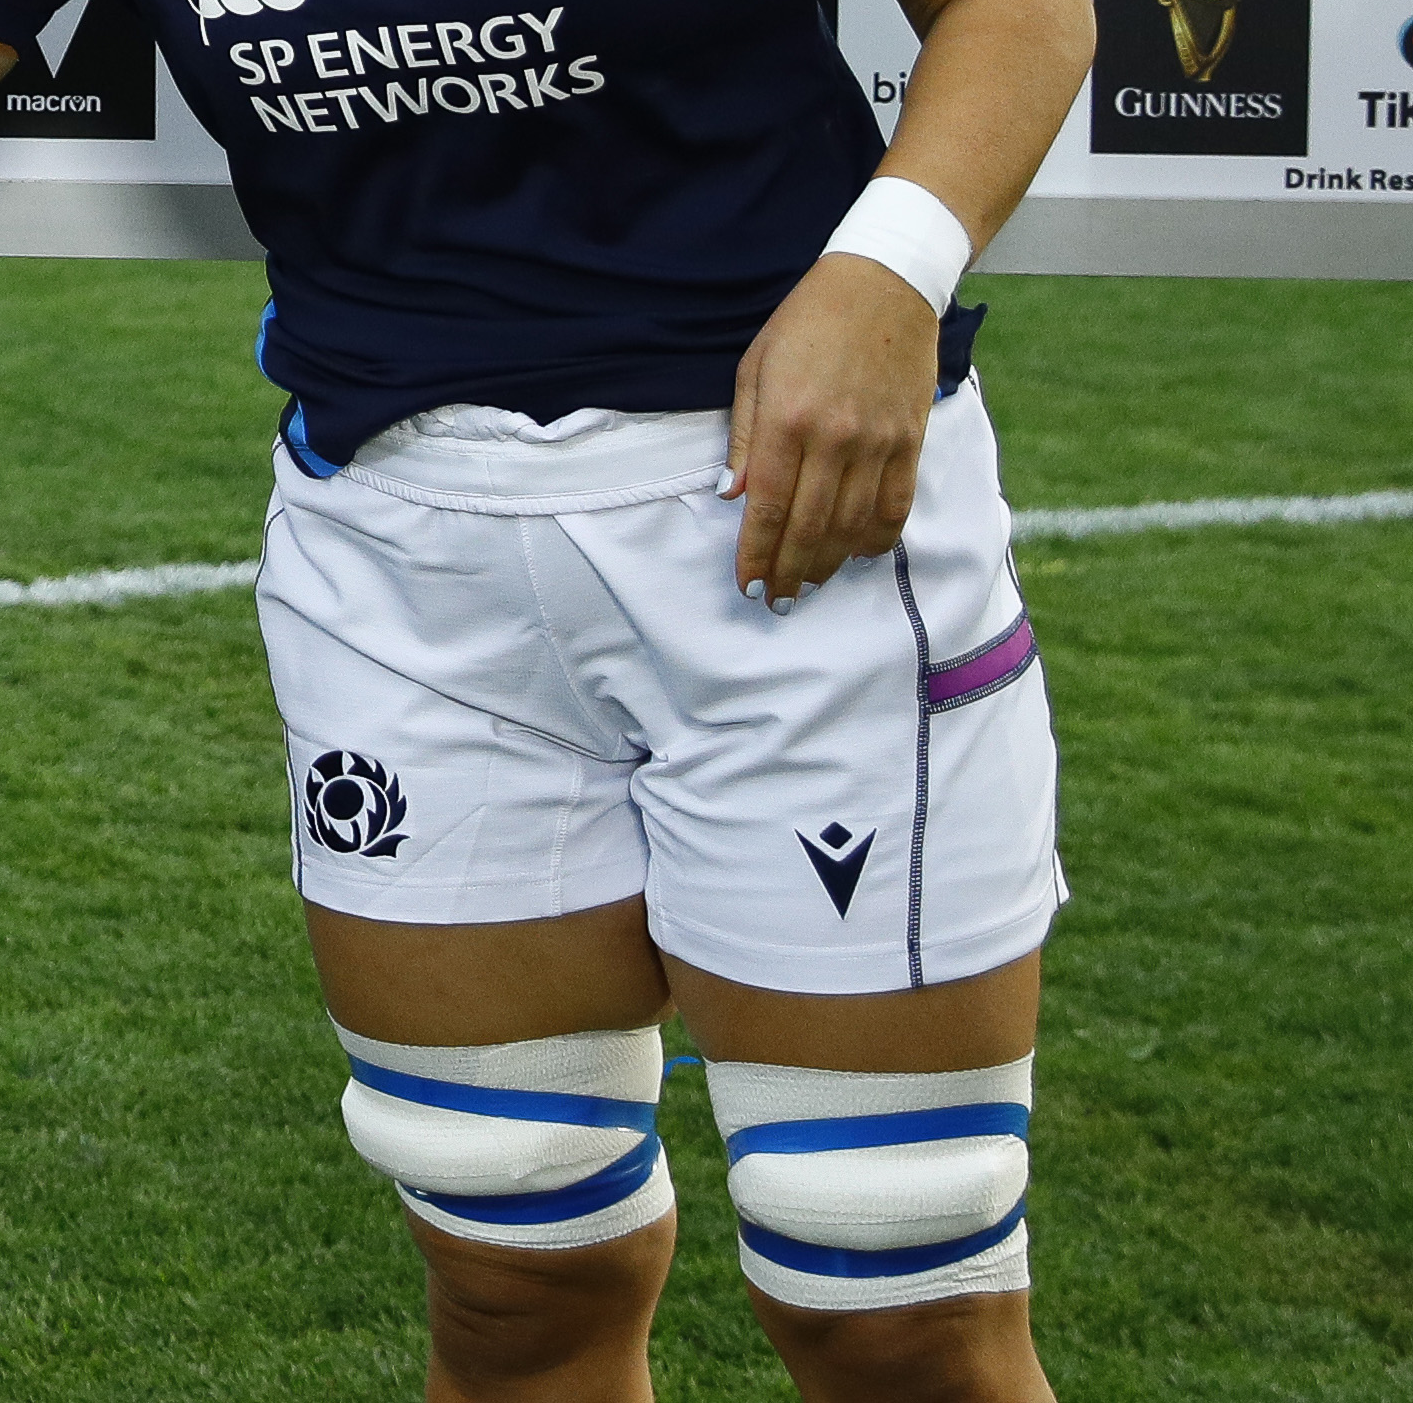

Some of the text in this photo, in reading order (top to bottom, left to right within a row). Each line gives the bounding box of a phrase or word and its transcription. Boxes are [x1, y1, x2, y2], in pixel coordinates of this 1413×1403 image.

[229, 6, 565, 86] SP ENERGY
[7, 95, 101, 112] macron
[249, 55, 606, 133] NETWORKS
[1115, 88, 1282, 118] GUINNESS
[1286, 168, 1361, 189] Drink
